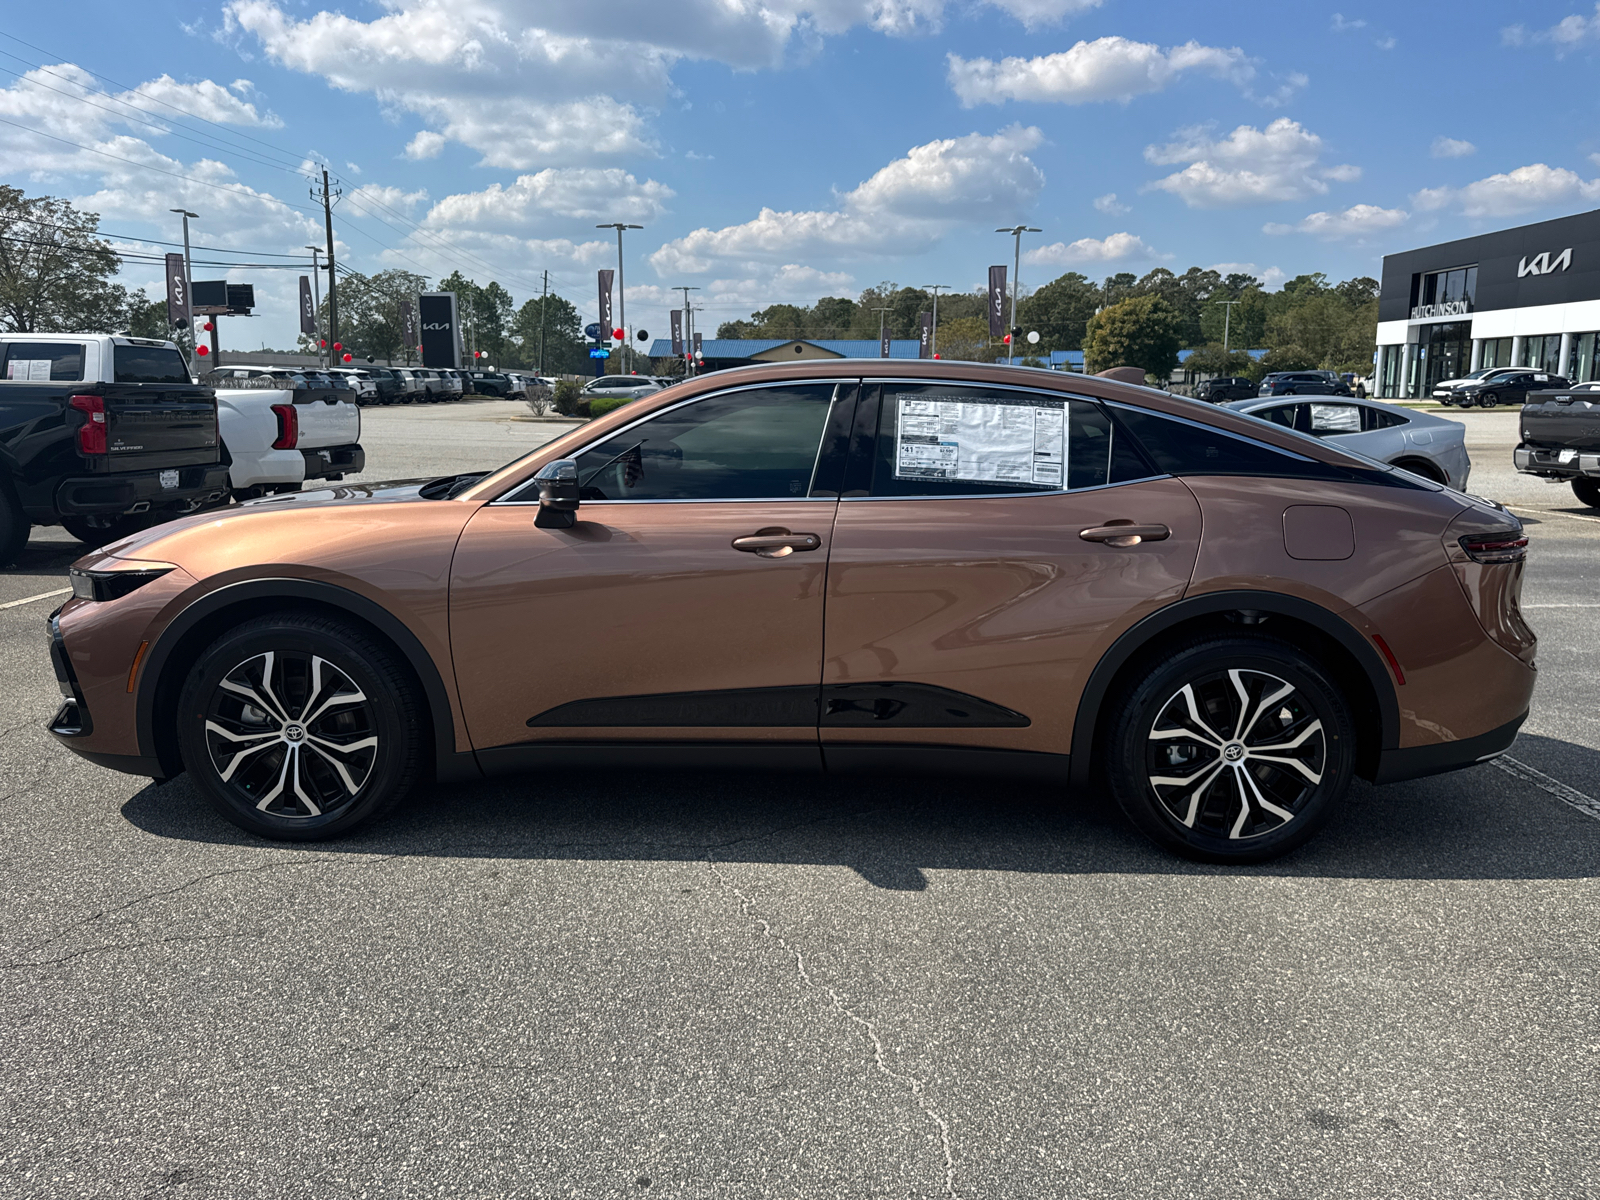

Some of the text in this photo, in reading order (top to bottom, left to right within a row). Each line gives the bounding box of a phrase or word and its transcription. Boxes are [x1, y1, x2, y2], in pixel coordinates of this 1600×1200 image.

[1517, 248, 1574, 278] KIA
[174, 275, 184, 306] KIA
[1411, 301, 1468, 320] HUTCHINSON
[422, 322, 450, 331] KIA
